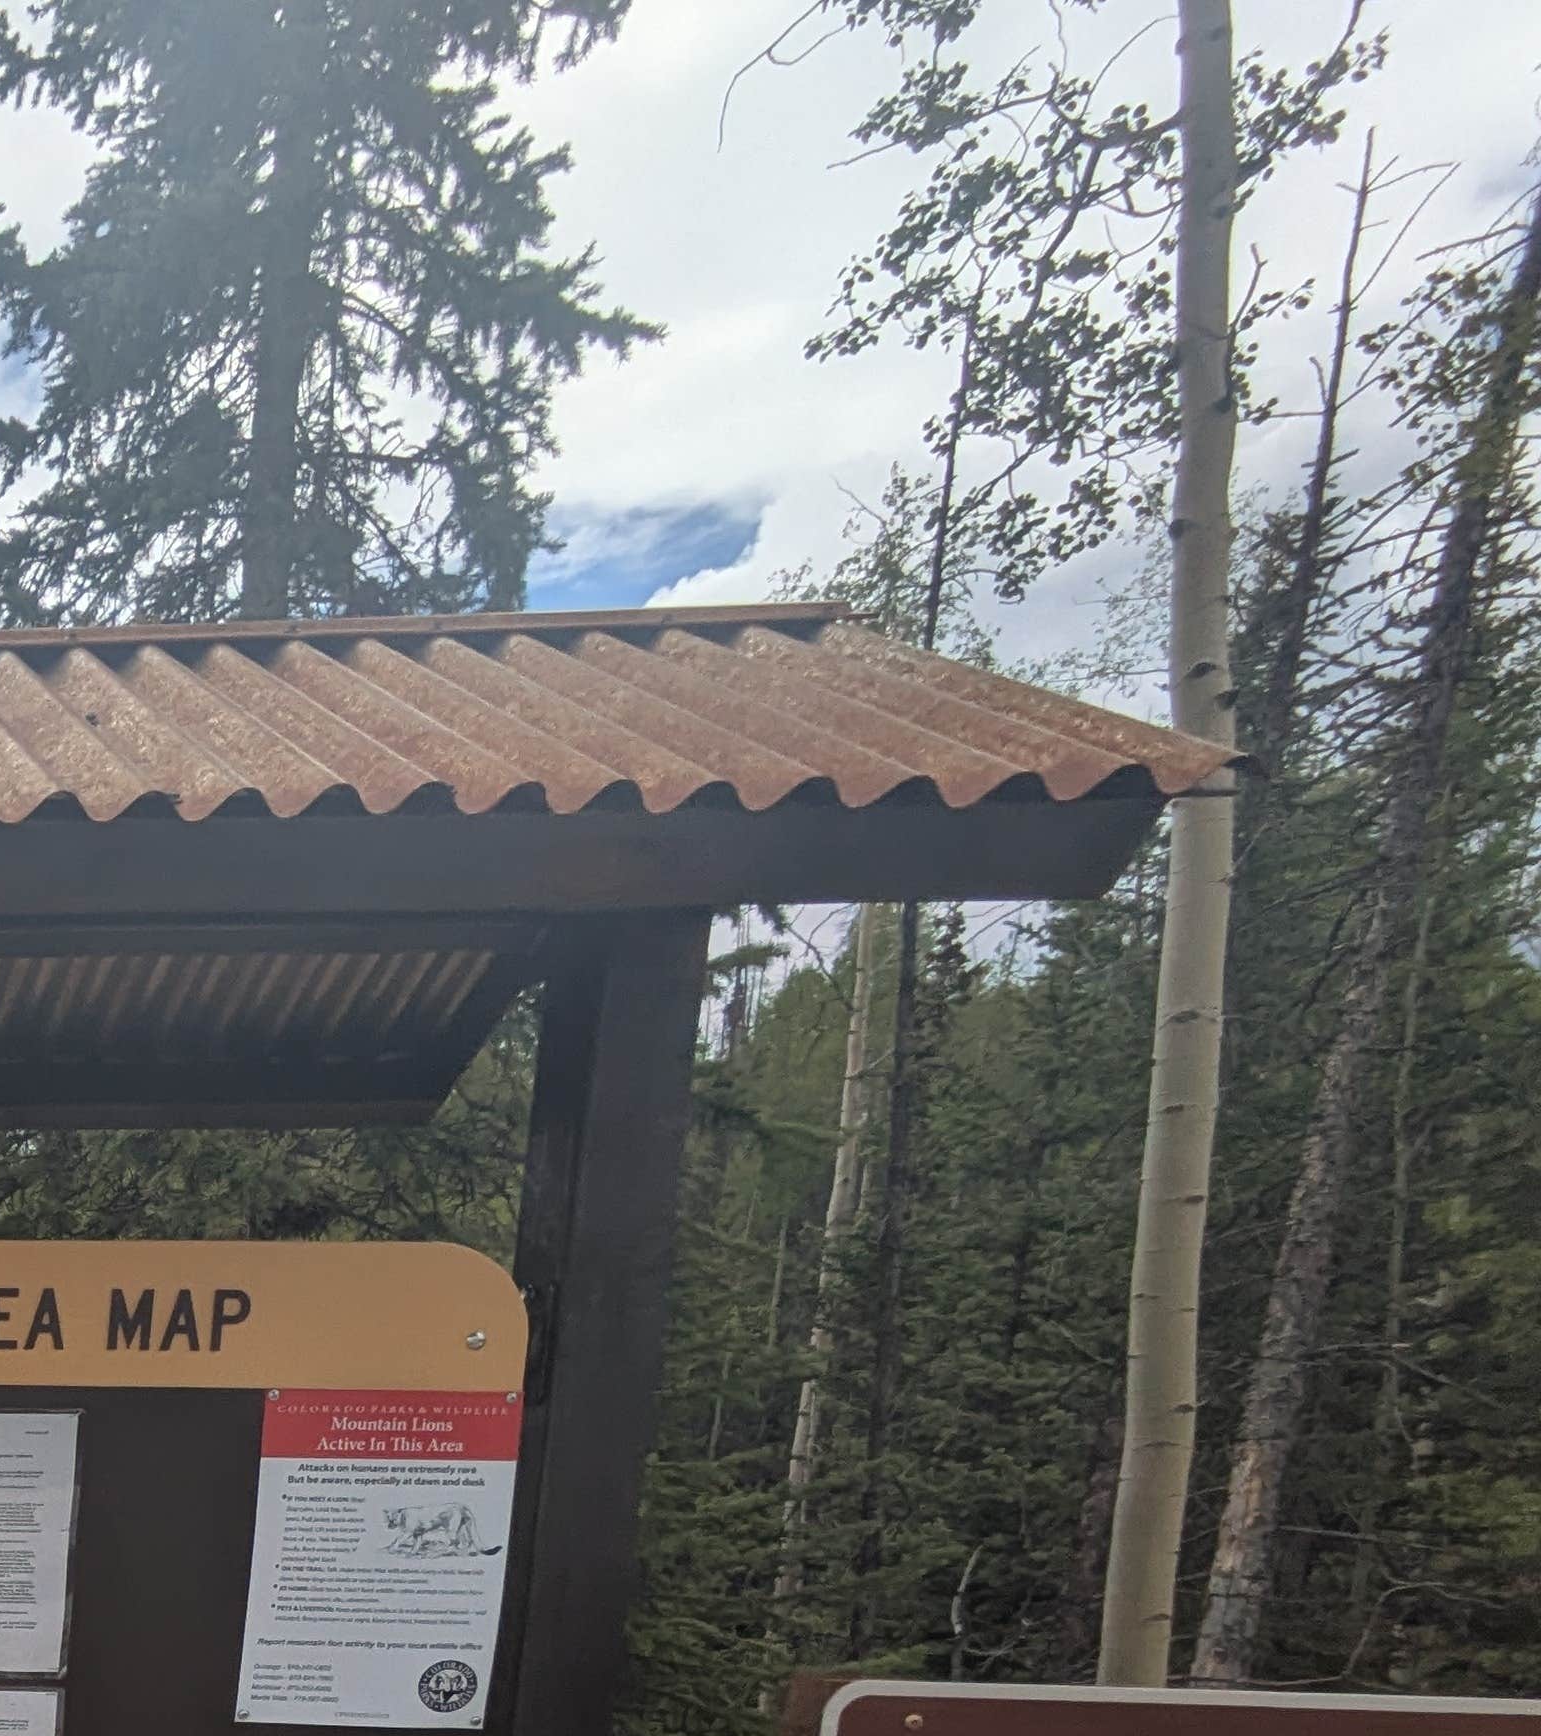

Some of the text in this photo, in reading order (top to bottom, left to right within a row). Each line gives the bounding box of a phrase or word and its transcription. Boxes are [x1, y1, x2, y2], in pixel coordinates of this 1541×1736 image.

[107, 1289, 252, 1352] MAP
[331, 1417, 453, 1432] Mountain Lions
[317, 1437, 463, 1452] Active In This Area
[298, 1464, 334, 1473] Attacks
[336, 1465, 349, 1473] on
[351, 1464, 389, 1473] humans
[408, 1465, 455, 1475] extremely
[288, 1475, 304, 1484] But
[306, 1475, 319, 1484] be
[354, 1476, 400, 1487] especially
[402, 1478, 412, 1486] at
[414, 1477, 440, 1486] dawn
[442, 1478, 460, 1486] and
[462, 1478, 485, 1487] dusk
